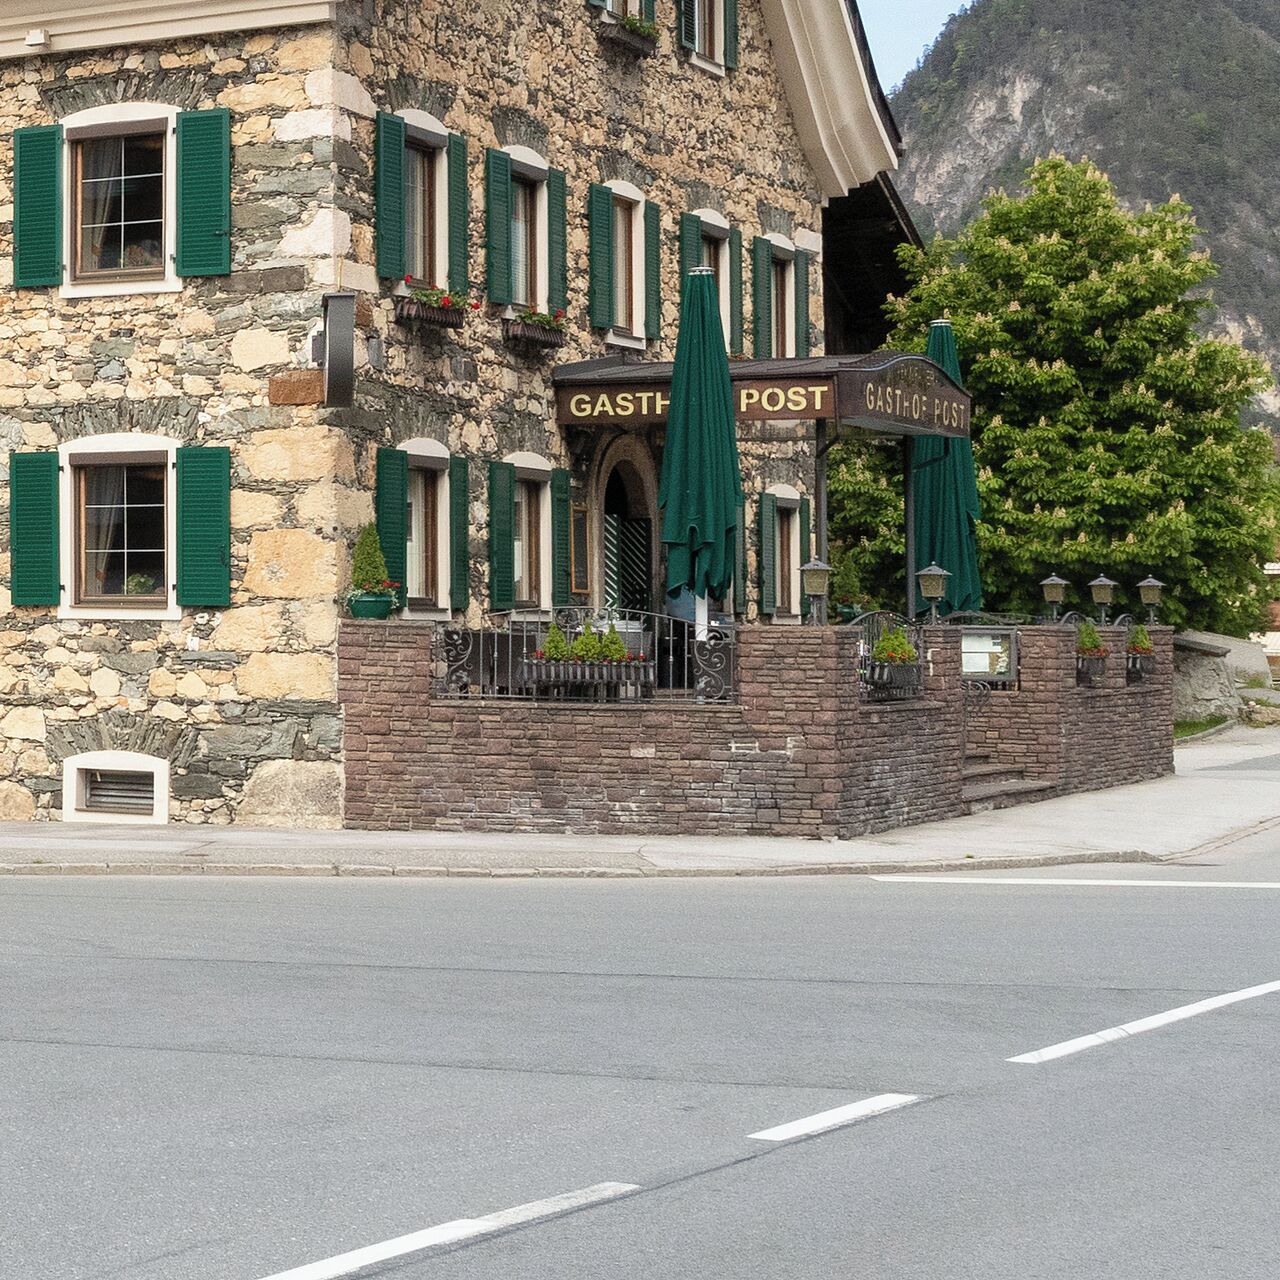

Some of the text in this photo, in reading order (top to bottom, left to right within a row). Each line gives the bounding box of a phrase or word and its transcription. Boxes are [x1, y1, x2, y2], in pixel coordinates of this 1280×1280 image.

[570, 386, 828, 417] GASTH POST
[865, 382, 965, 429] GASTHOF POST
